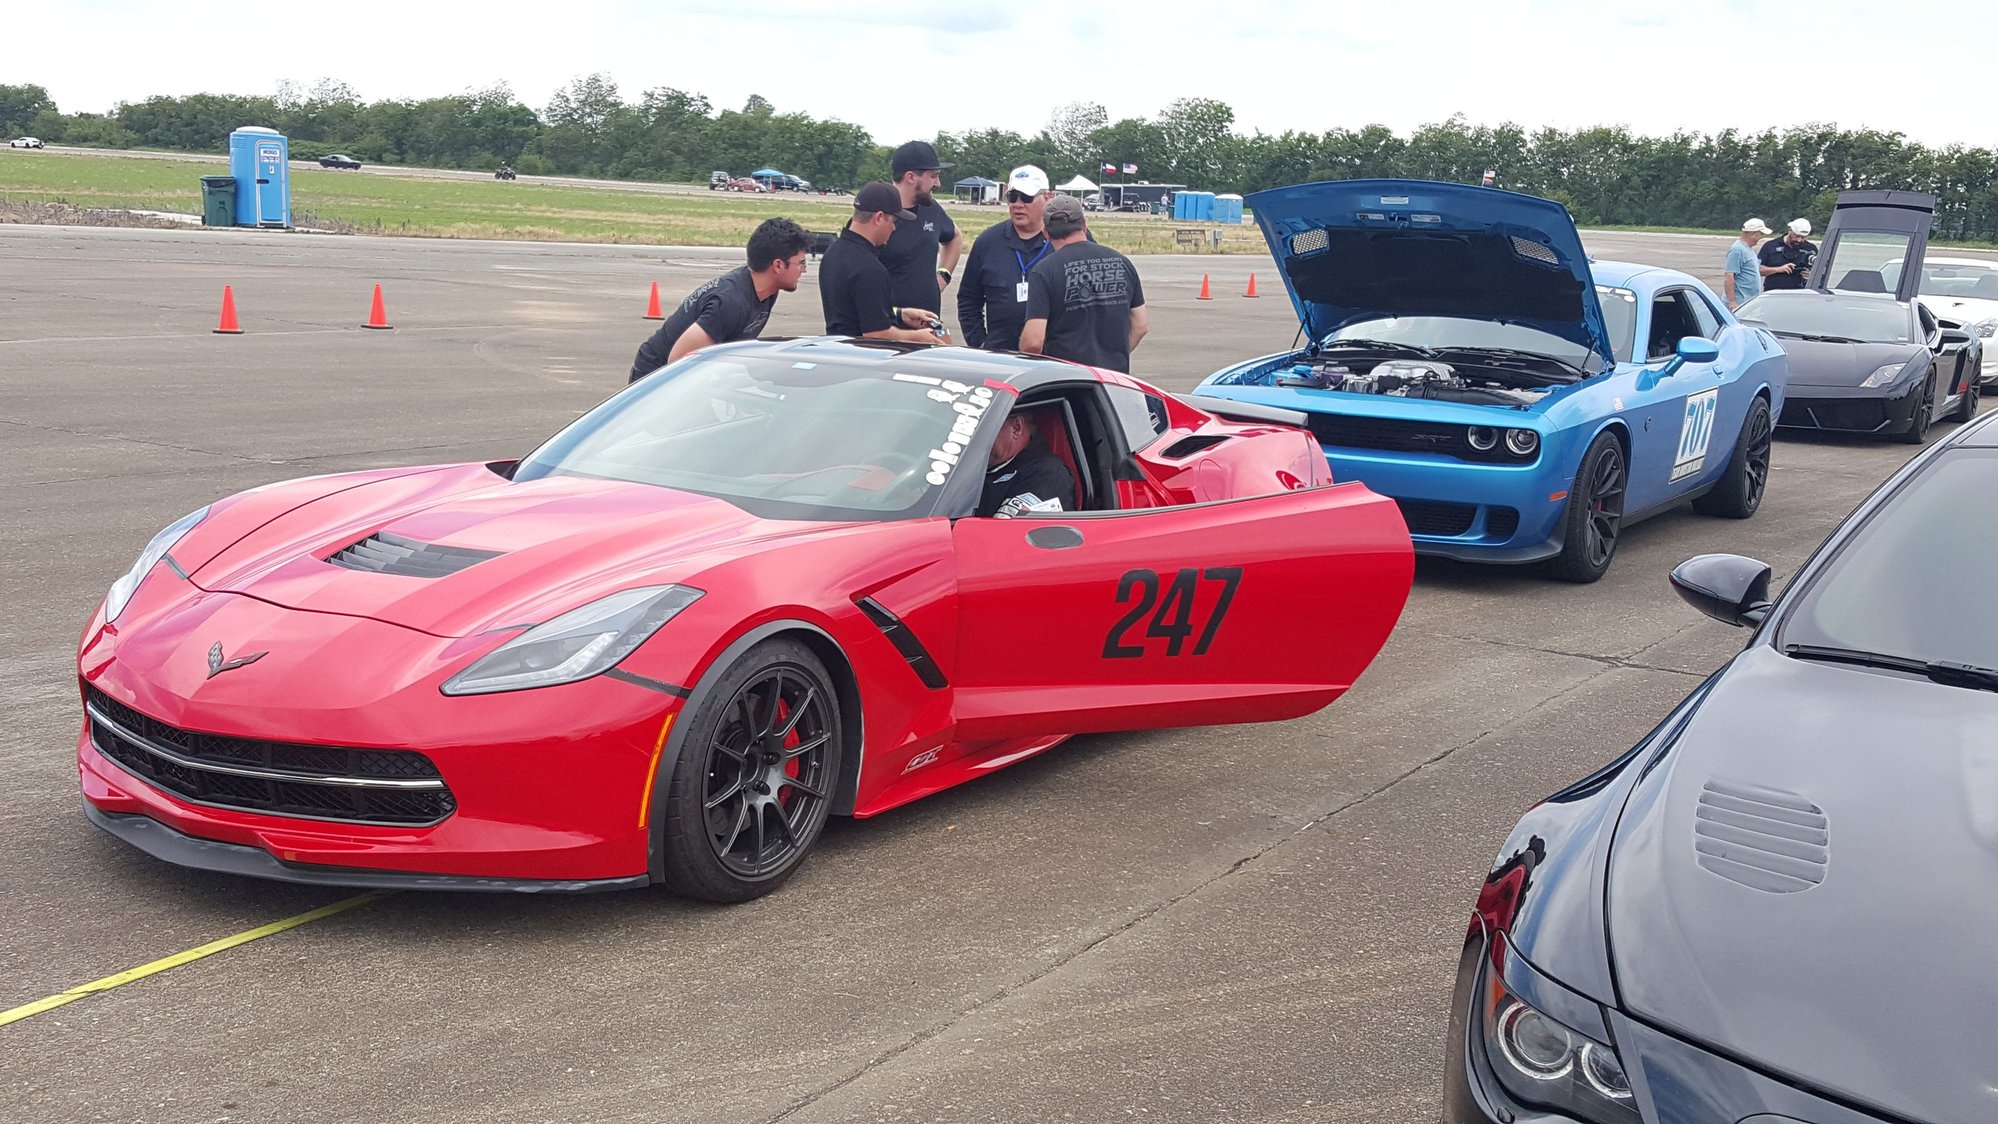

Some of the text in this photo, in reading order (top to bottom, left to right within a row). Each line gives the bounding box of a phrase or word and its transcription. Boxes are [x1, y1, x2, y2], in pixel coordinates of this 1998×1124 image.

[1065, 262, 1124, 276] FOR STOCK
[1066, 269, 1126, 288] HORSE
[1681, 396, 1715, 457] 707
[1101, 567, 1244, 659] 247
